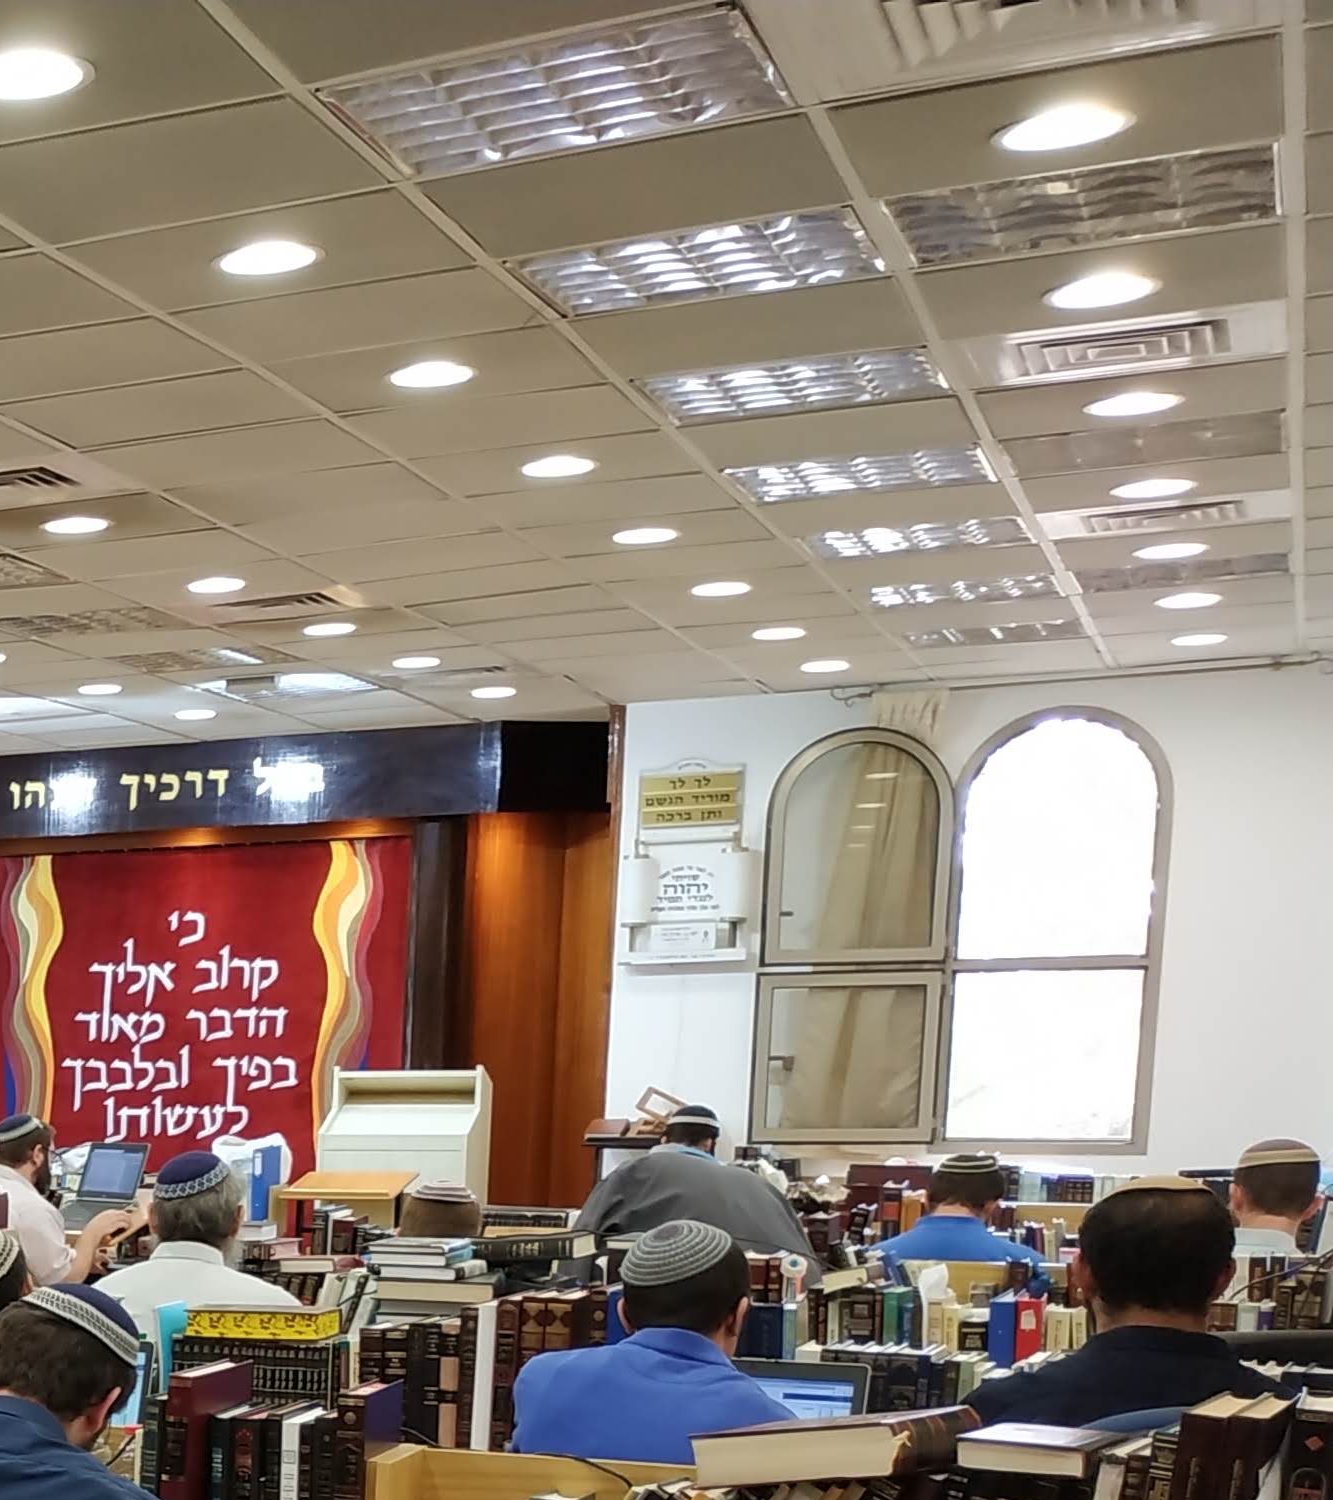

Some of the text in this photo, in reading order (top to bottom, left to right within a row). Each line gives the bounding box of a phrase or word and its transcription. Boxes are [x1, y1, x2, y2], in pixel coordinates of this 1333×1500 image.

[119, 768, 231, 811] דרכיך
[691, 792, 731, 804] מוריד
[655, 810, 723, 824] ותן ברכה
[662, 881, 709, 896] יהוה
[167, 909, 206, 948] כי
[88, 937, 280, 1008] קרוב אליך
[74, 1004, 289, 1045] הדבר מאוד
[60, 1043, 299, 1113] בפיך ובלבבך
[102, 1095, 250, 1144] לעשותו
